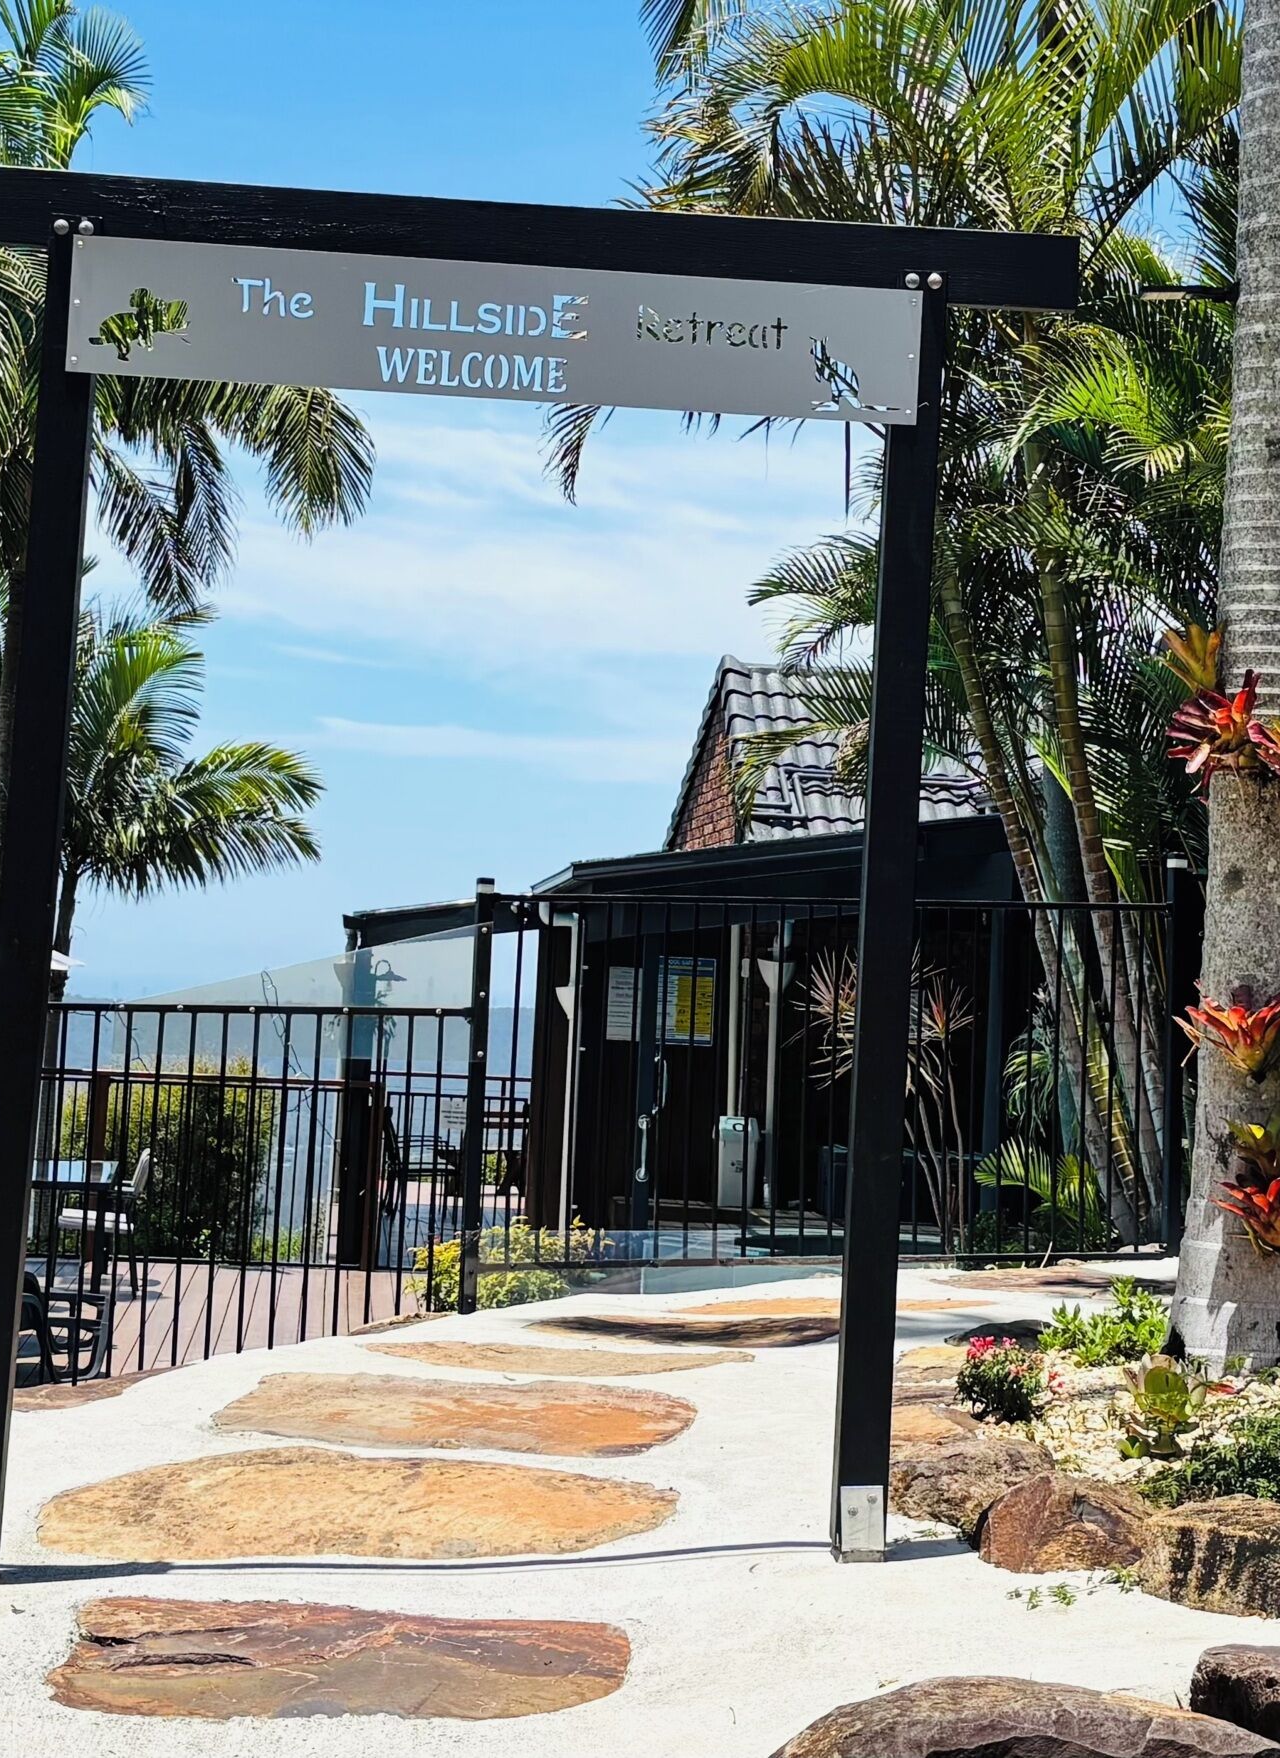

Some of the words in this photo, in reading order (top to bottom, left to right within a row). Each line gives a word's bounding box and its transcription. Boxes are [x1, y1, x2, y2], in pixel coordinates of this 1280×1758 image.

[230, 276, 314, 320] The
[362, 281, 589, 340] HILLSIDE
[635, 304, 789, 350] Retreat
[376, 346, 568, 393] WELCOME
